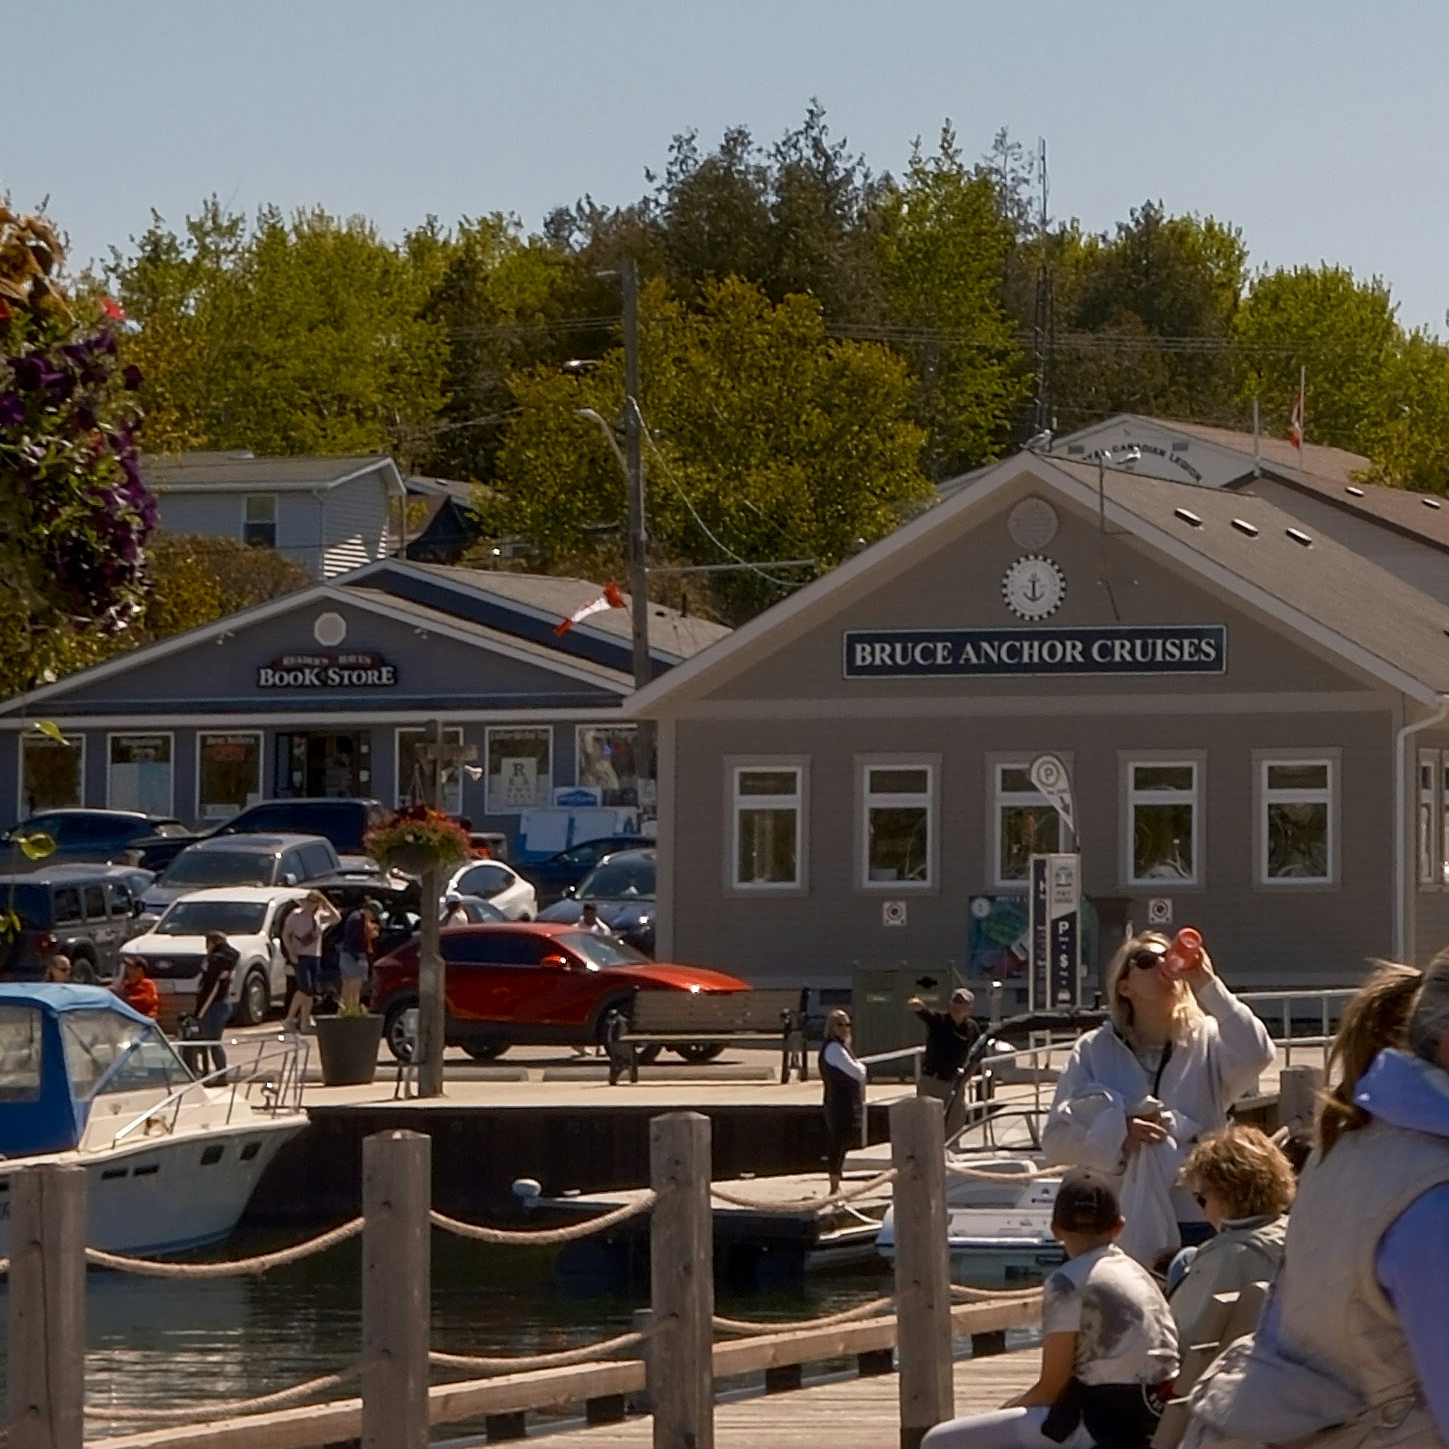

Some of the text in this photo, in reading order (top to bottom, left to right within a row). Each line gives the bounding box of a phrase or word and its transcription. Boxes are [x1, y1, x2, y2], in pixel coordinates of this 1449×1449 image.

[855, 638, 1217, 667] BRUCE ANCHOR CRUISES
[259, 666, 396, 687] BOOK STORE
